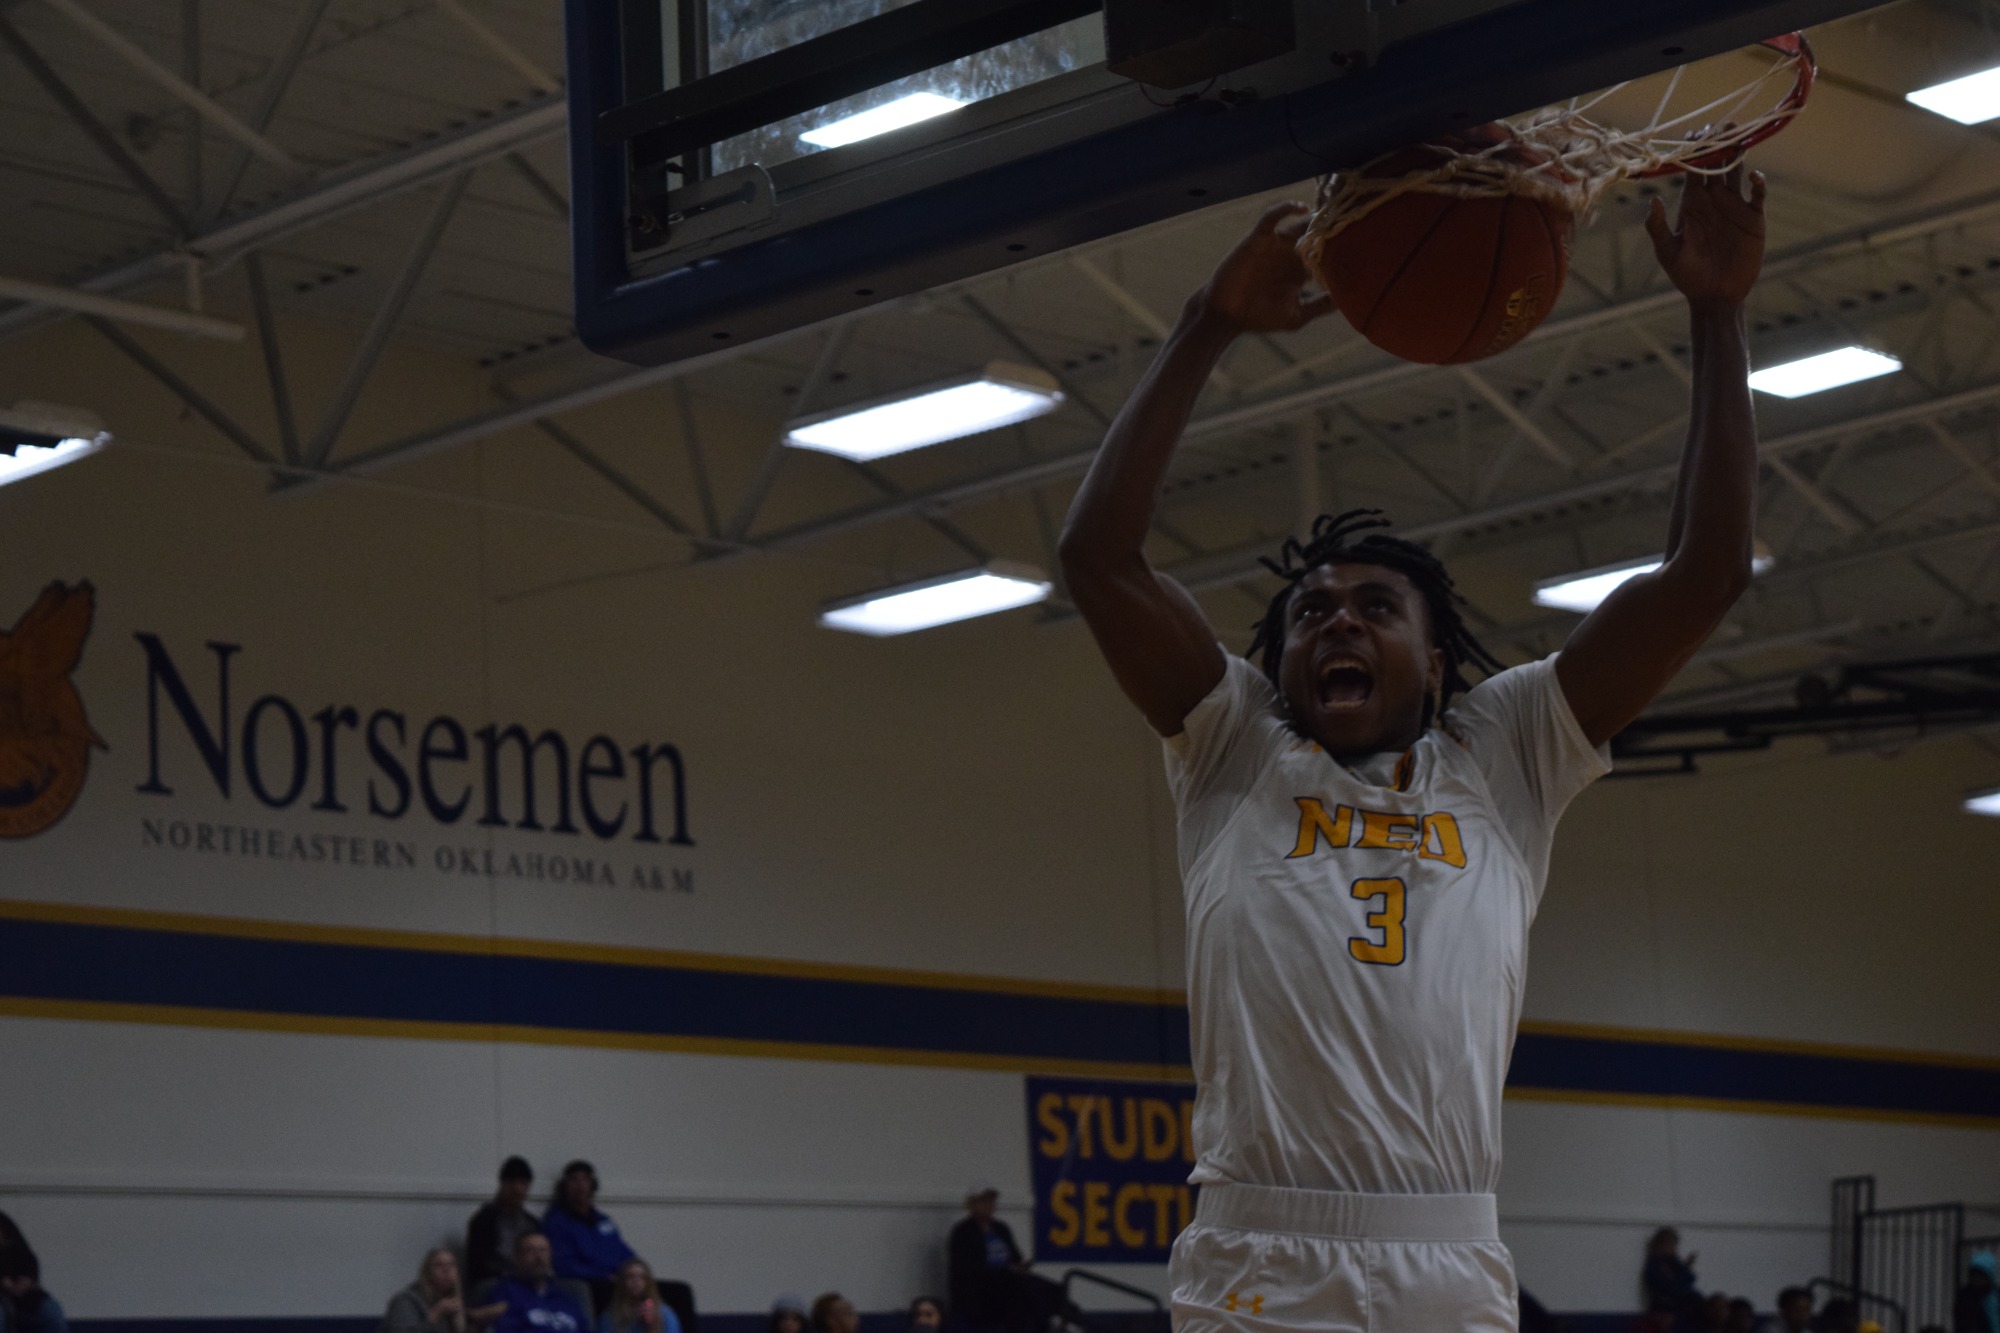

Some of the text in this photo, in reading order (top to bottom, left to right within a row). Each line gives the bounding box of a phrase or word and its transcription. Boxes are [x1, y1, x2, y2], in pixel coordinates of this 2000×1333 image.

[134, 632, 696, 846] Norsemen
[141, 819, 696, 895] NORTHEASTERN OKLAHOMA A&M
[1284, 797, 1466, 868] NEO
[1349, 877, 1406, 966] 3
